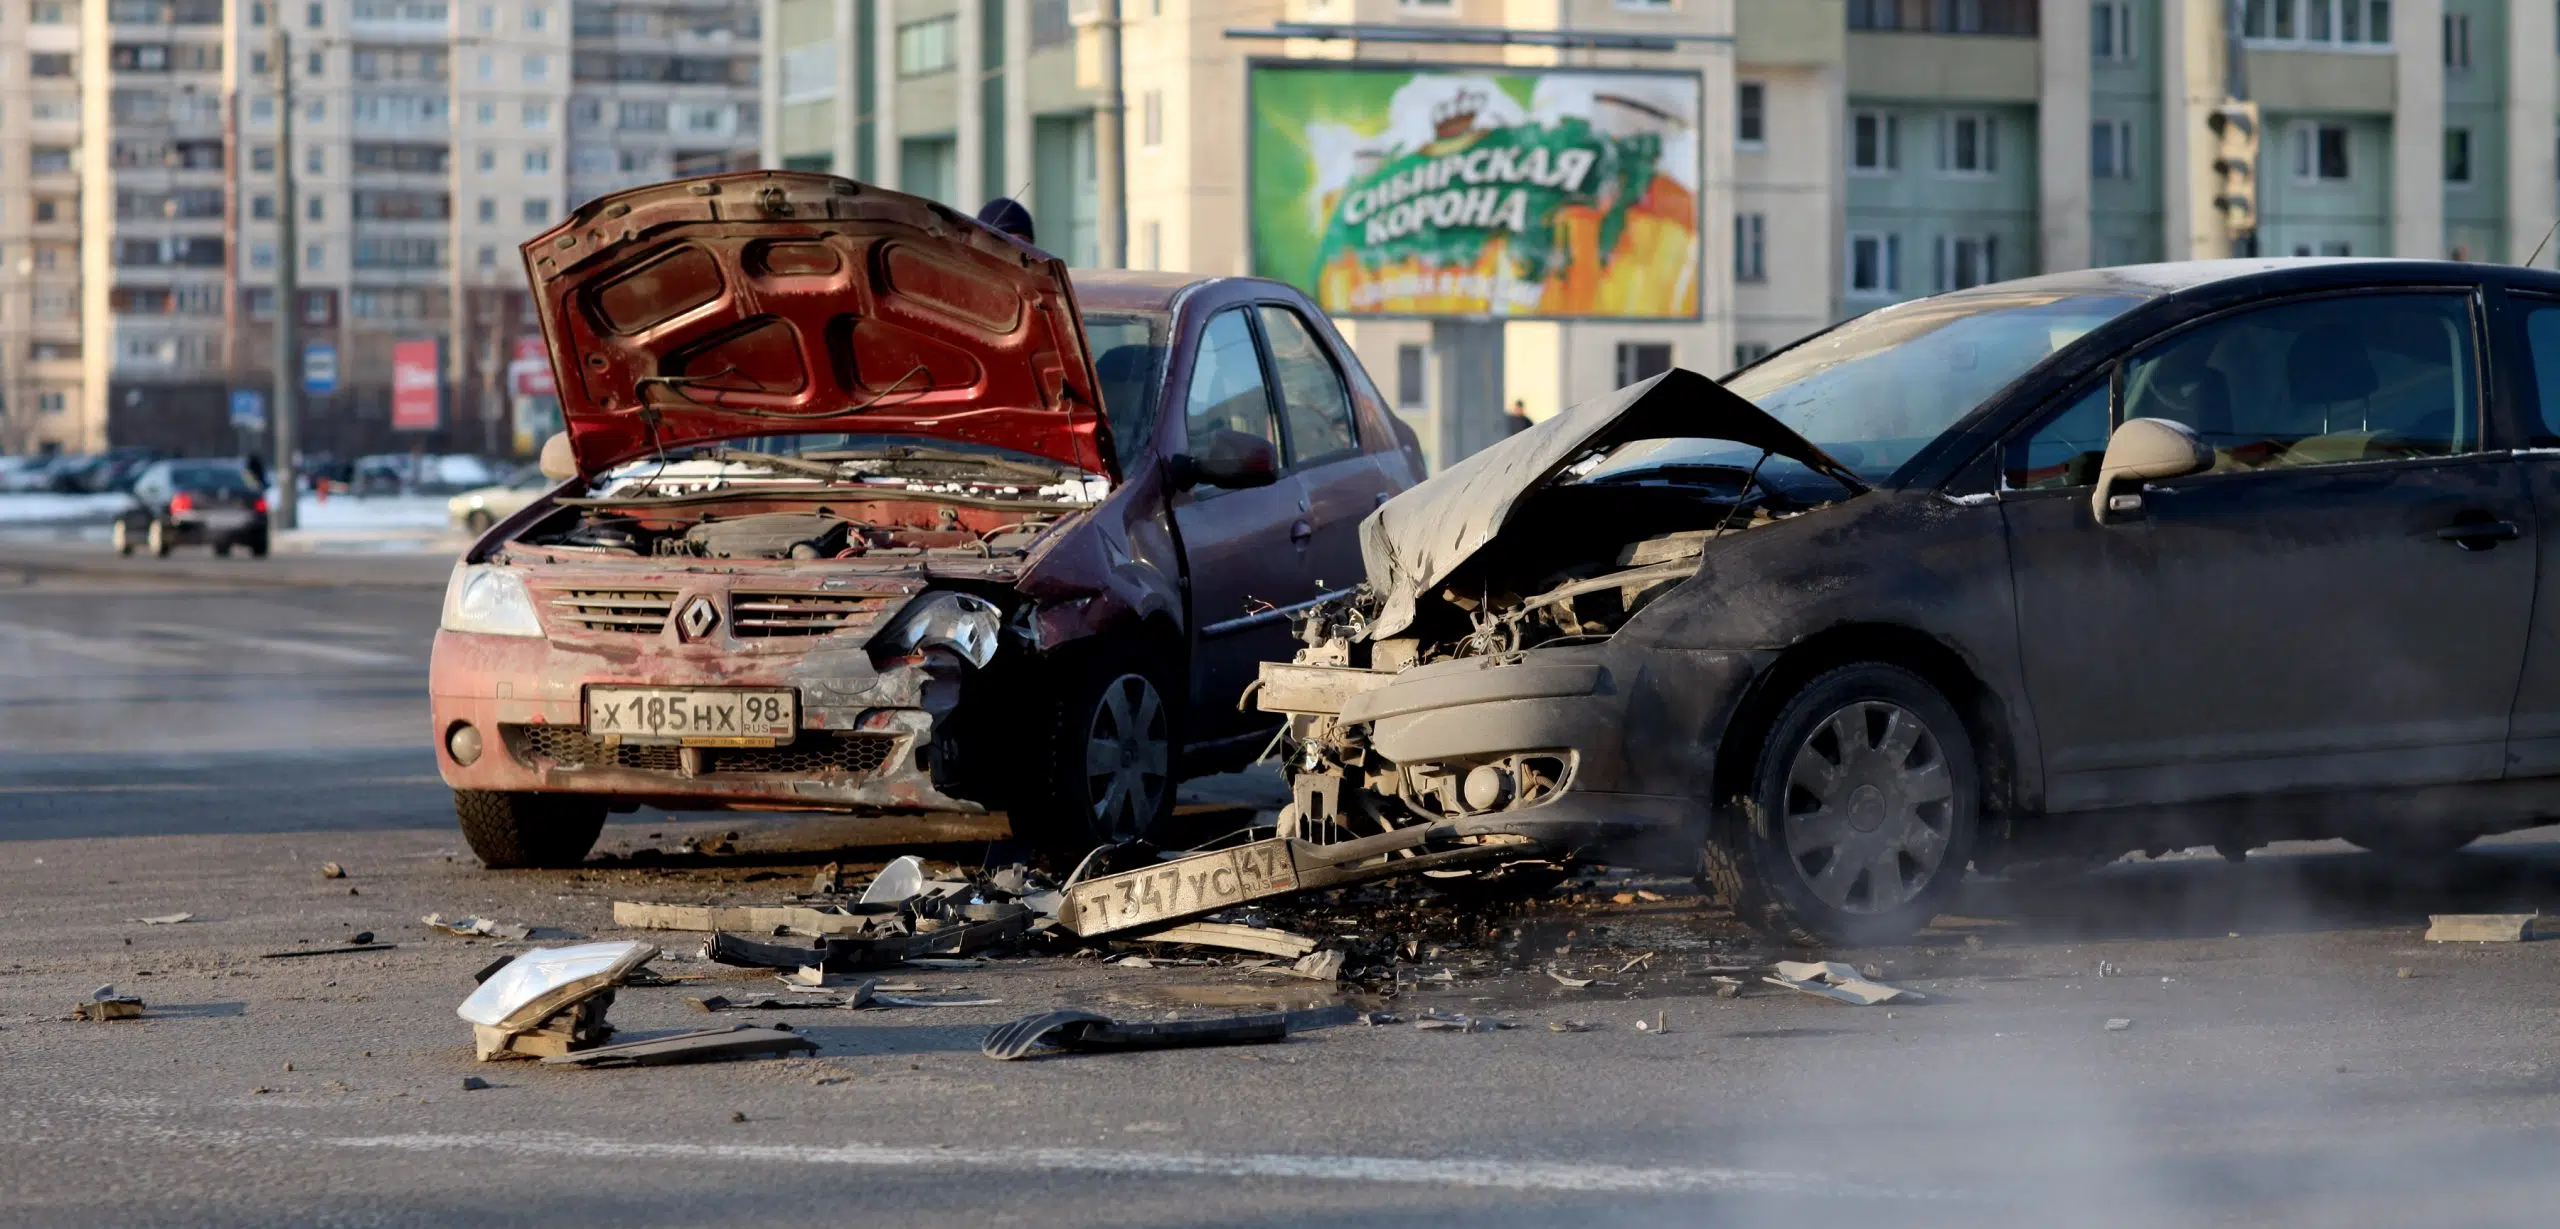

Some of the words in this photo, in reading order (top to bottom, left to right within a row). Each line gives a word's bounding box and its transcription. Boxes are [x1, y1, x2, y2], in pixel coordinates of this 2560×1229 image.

[1344, 146, 1597, 225] СИБИРСКАЯ
[1365, 190, 1527, 245] КОРОНА
[744, 723, 769, 733] RUS
[1244, 881, 1271, 894] RUS
